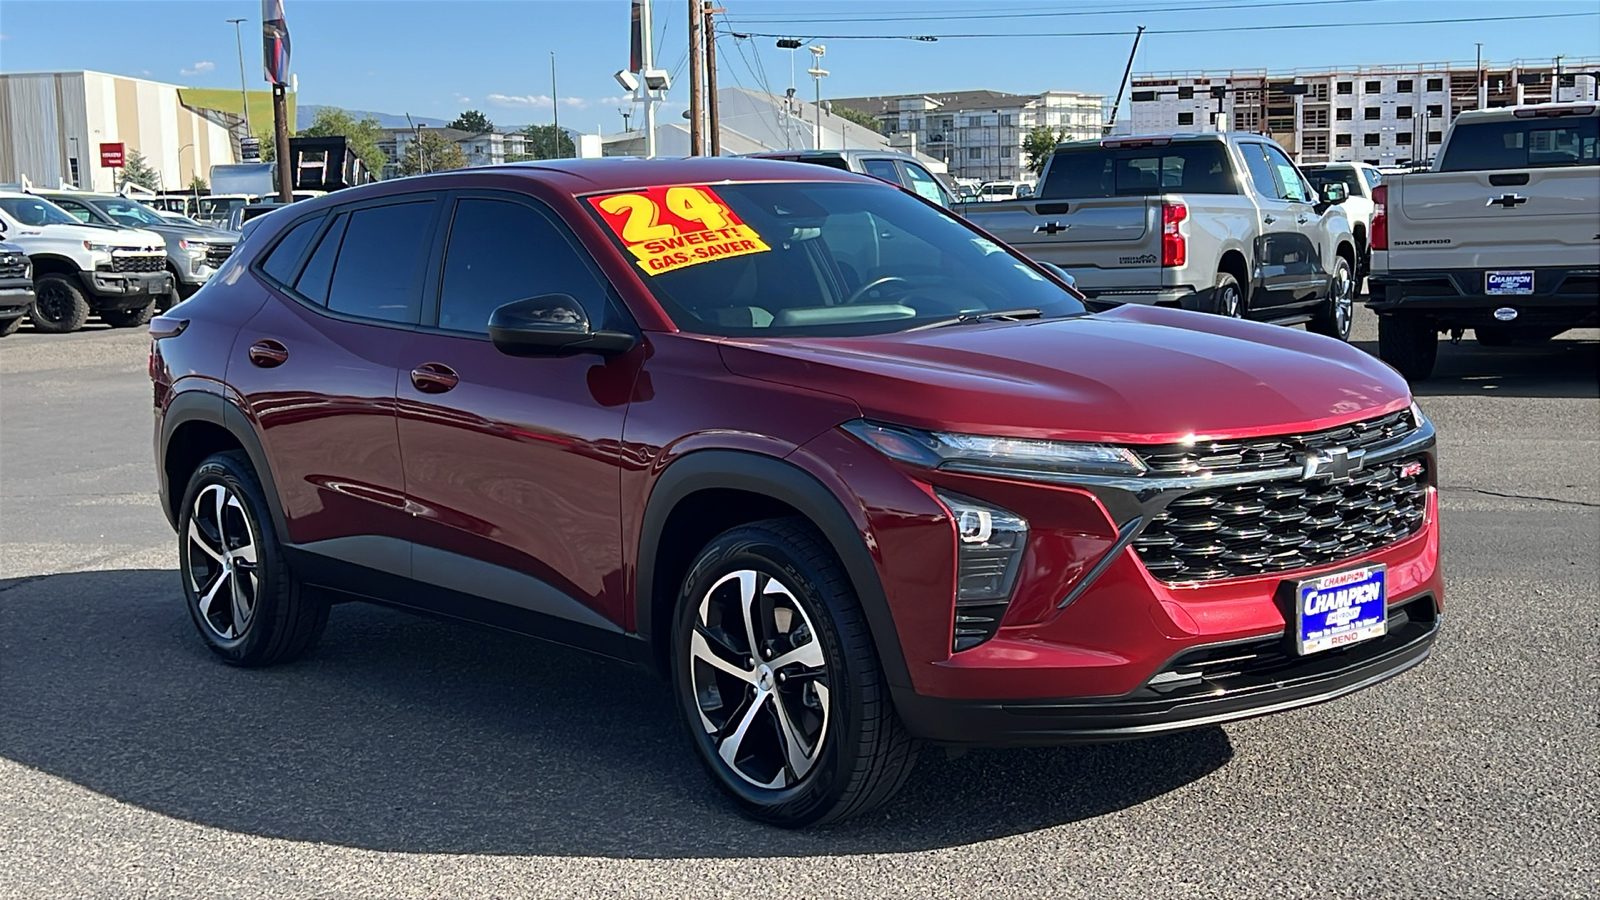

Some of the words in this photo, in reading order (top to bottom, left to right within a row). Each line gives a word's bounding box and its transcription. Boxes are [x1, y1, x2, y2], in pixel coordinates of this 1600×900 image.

[599, 187, 731, 243] 24
[644, 227, 742, 254] SWEET!
[1394, 238, 1451, 246] SILVERADO
[648, 239, 756, 271] GAS-SAVER
[1489, 275, 1531, 283] CHAMPION
[1323, 571, 1365, 587] CHAMPION
[1304, 582, 1380, 616] CHAMPION
[1331, 632, 1358, 645] RENO
